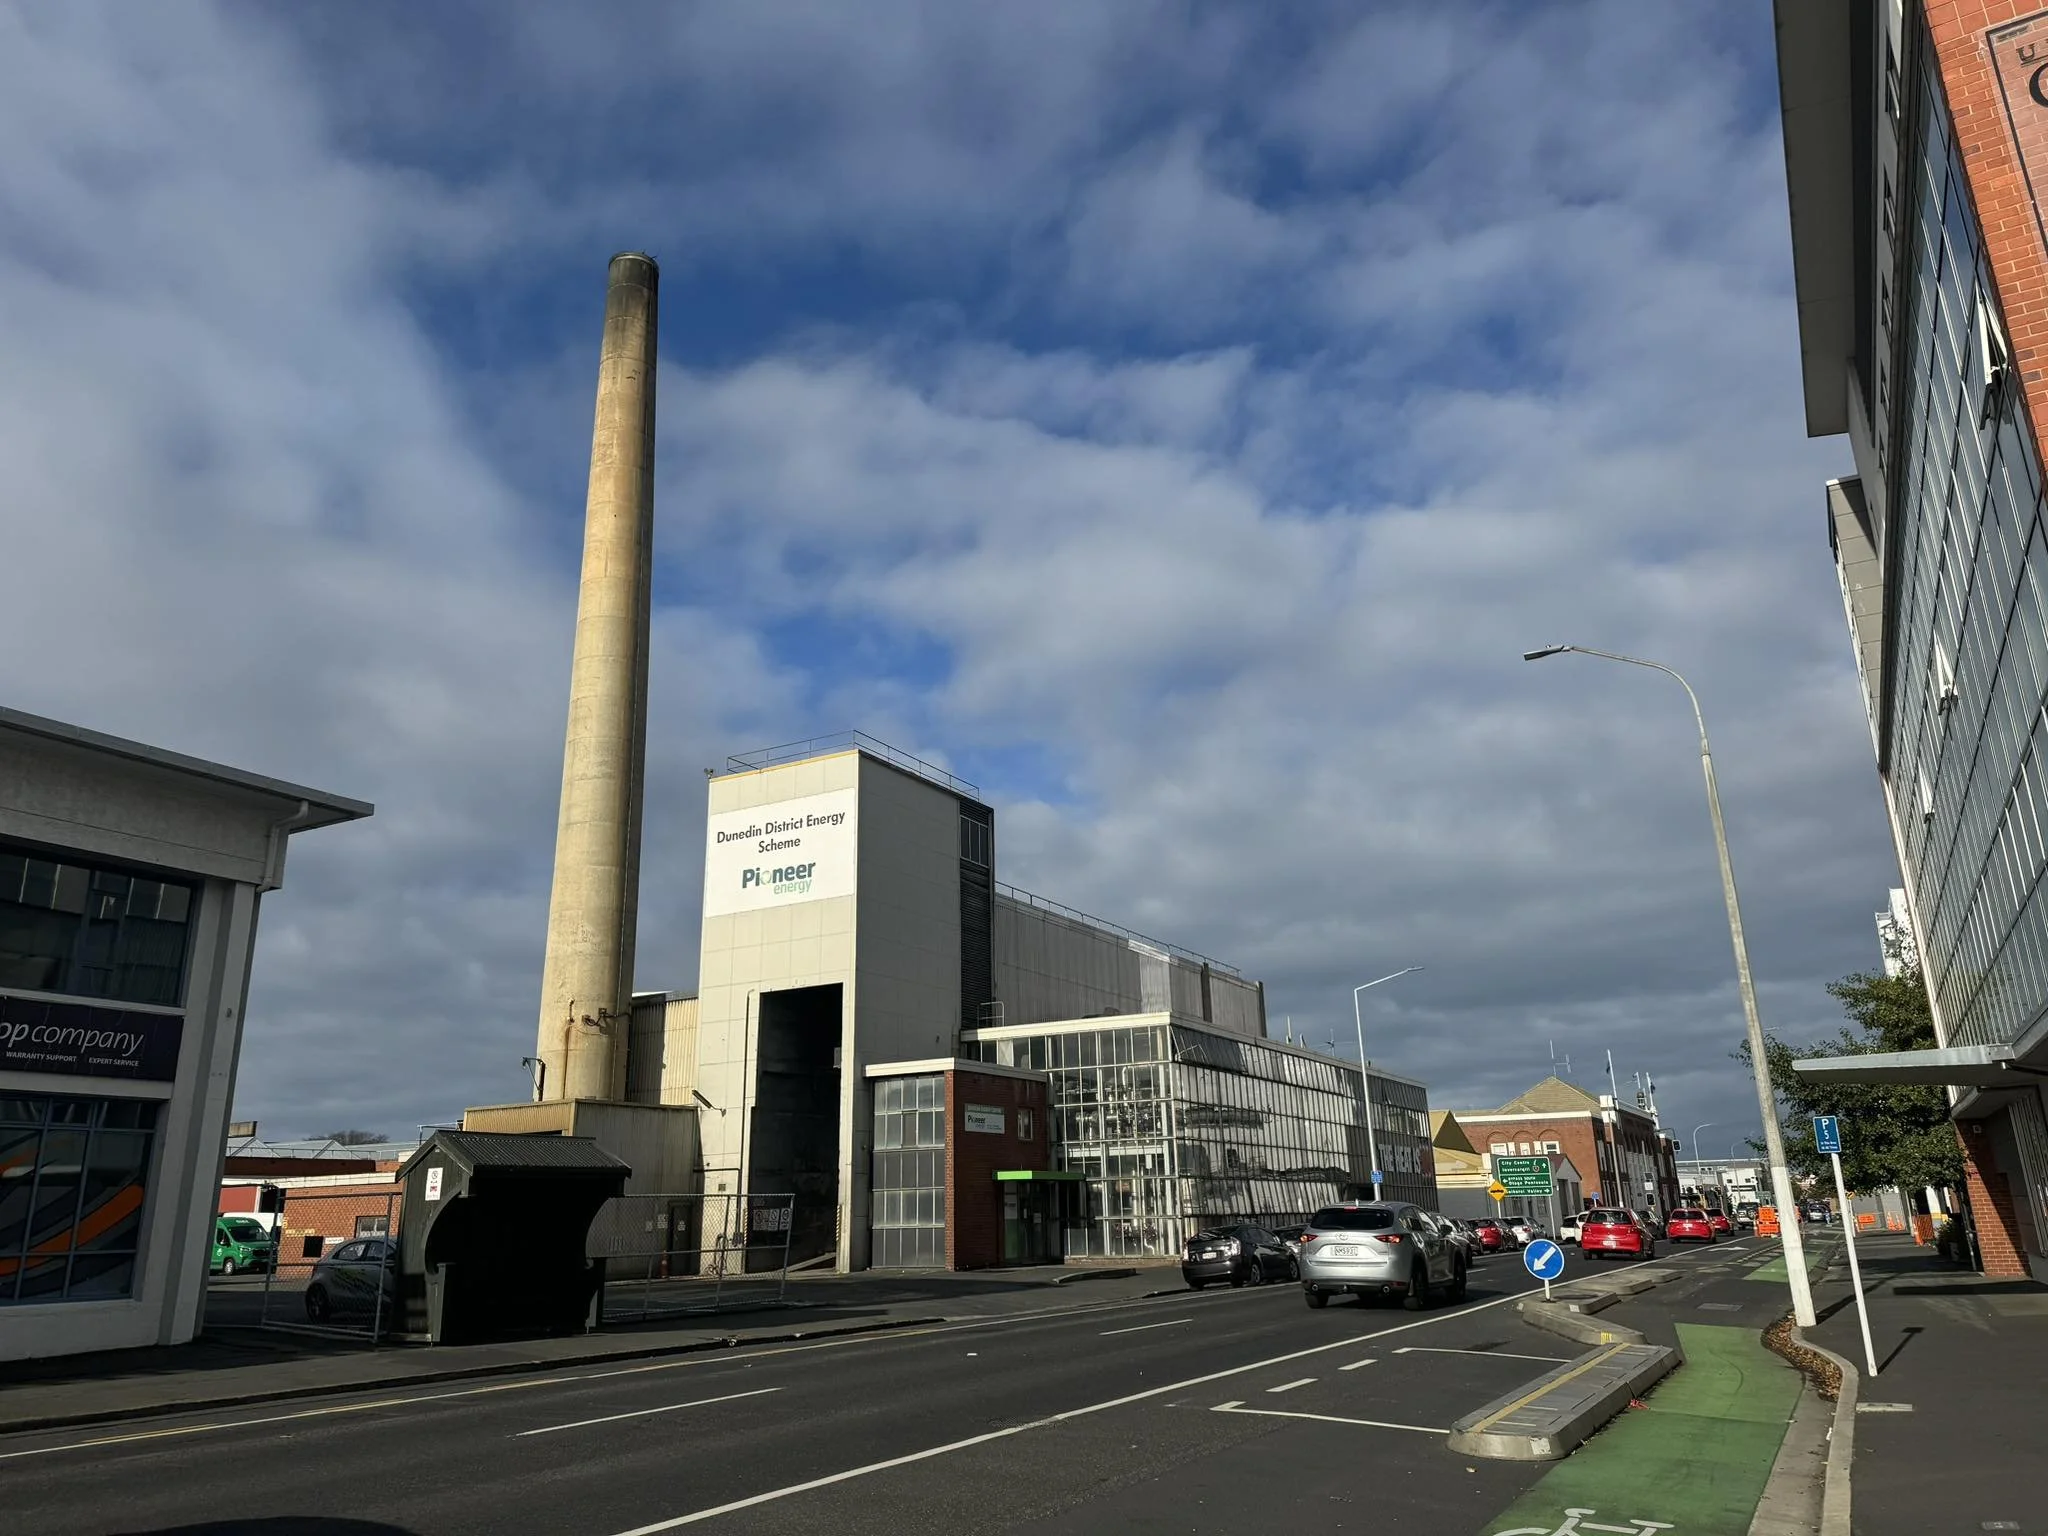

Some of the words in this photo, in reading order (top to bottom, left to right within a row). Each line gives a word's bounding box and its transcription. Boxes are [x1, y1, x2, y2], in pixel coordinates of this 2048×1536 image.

[717, 825, 762, 843] Dunedin
[765, 818, 803, 834] District
[806, 812, 845, 827] Energy
[758, 838, 801, 853] Scheme
[742, 862, 816, 889] Pioneer
[773, 880, 812, 895] energy
[31, 1025, 144, 1057] company
[6, 1051, 45, 1060] WARRANTY
[46, 1054, 77, 1062] SUPPORT
[88, 1057, 113, 1065] EXPERT
[113, 1059, 140, 1067] SERVICE
[1822, 1119, 1829, 1130] P
[1378, 1144, 1395, 1172] THE
[1394, 1145, 1412, 1173] HEAT
[1412, 1147, 1421, 1174] IS
